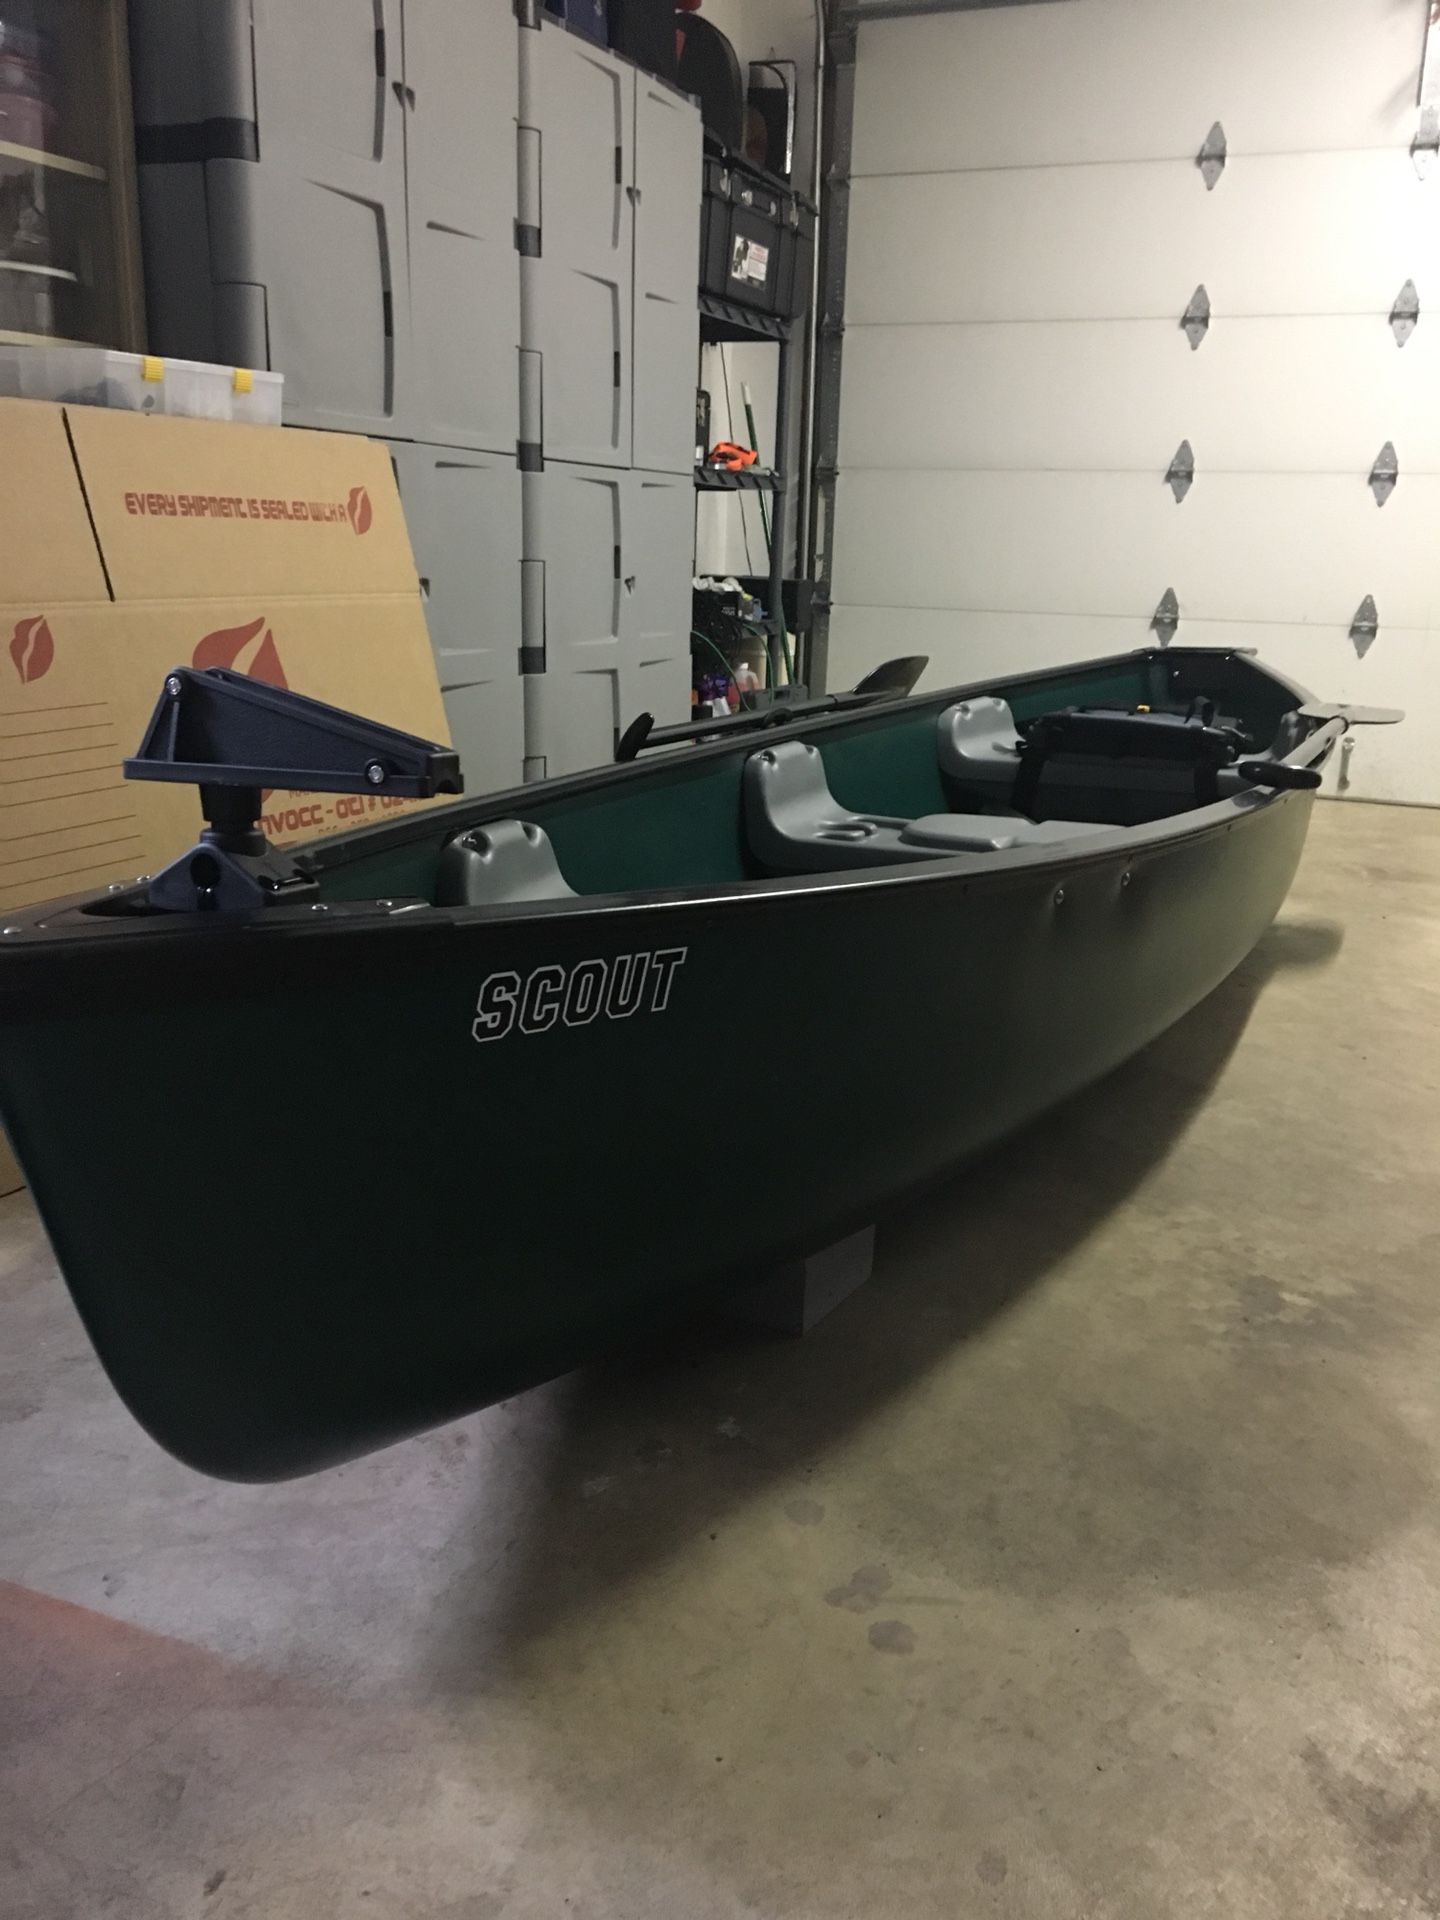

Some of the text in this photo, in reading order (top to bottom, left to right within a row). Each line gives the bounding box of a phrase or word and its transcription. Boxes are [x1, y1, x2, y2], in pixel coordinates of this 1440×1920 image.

[124, 492, 178, 517] EVERY
[178, 495, 248, 519] SHIPMENT
[246, 498, 261, 519] IS
[261, 499, 309, 521] SEALED
[338, 503, 348, 522] A
[472, 947, 688, 1042] SCOUT
